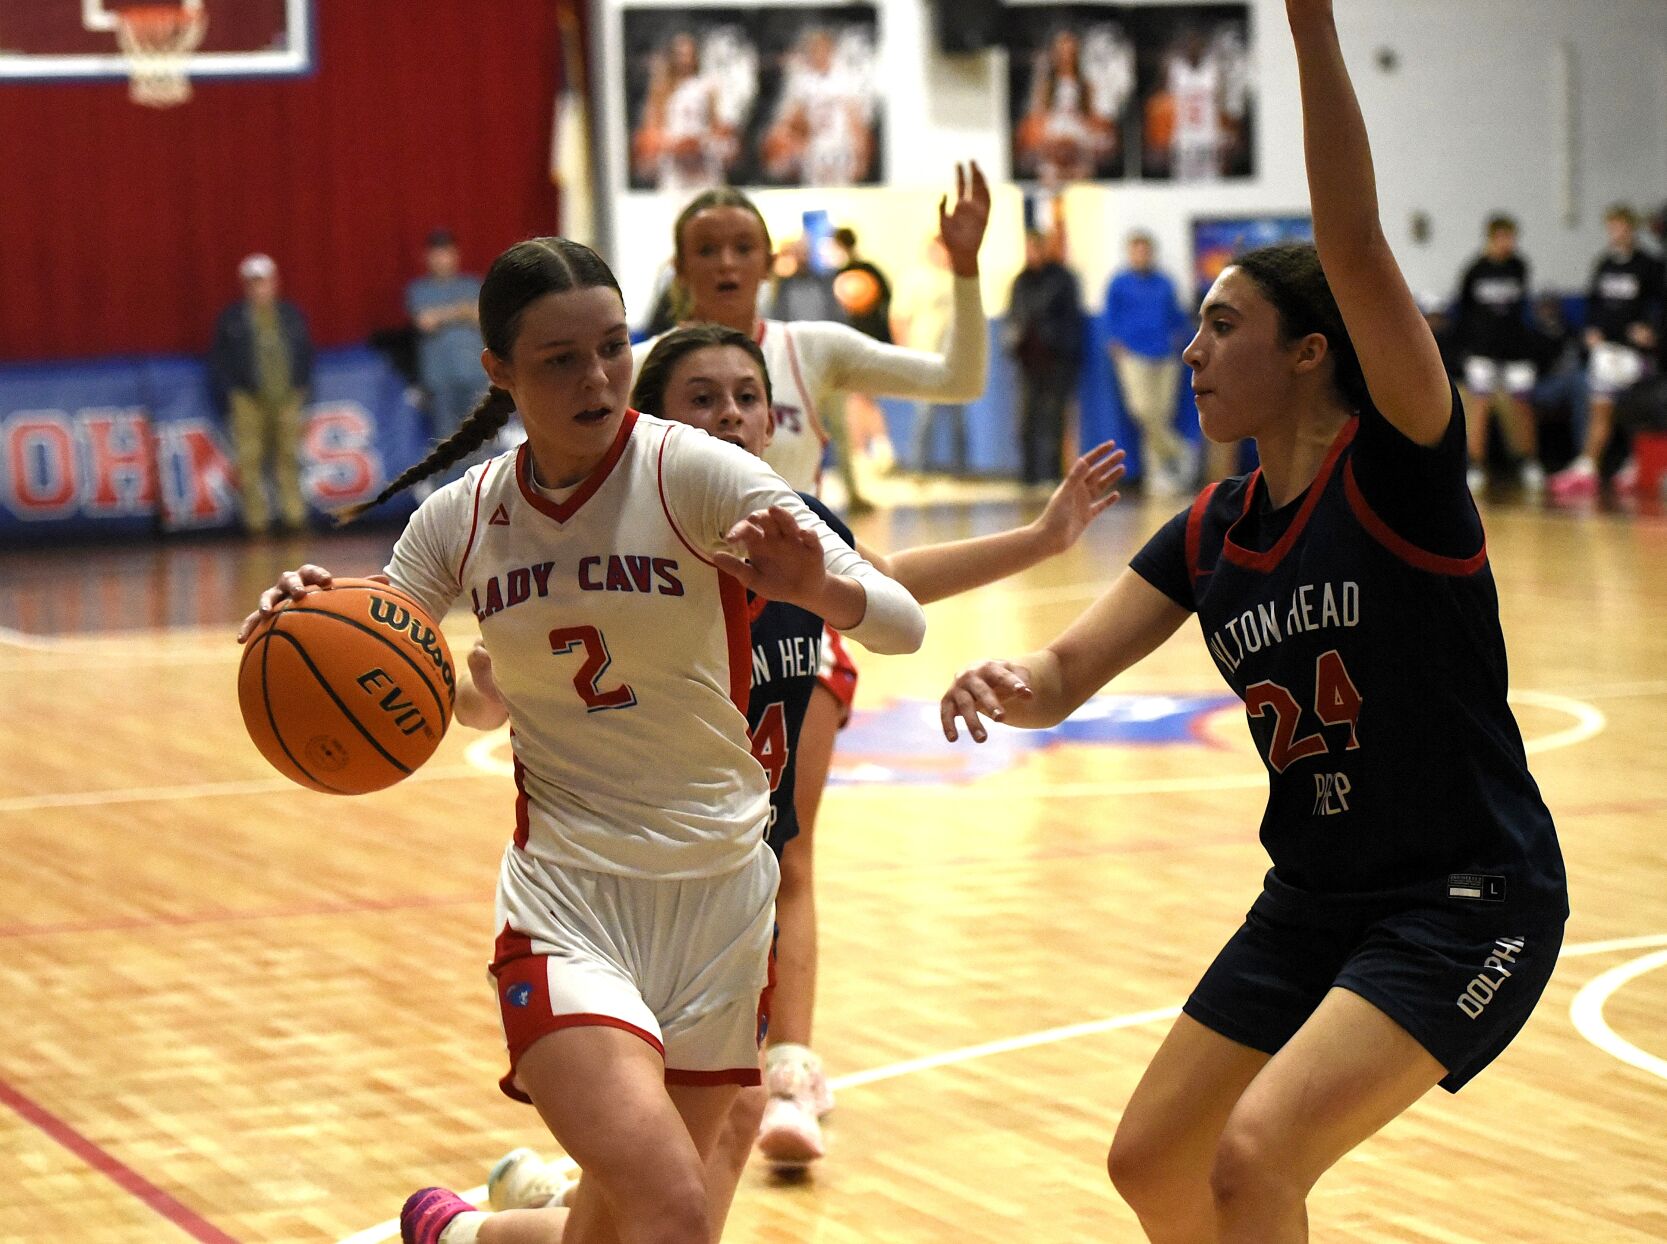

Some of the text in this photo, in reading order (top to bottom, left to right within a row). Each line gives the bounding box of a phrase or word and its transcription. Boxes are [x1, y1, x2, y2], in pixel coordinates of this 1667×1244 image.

[471, 555, 685, 623] LADY CAVS
[1287, 577, 1360, 636] HEAD
[548, 625, 637, 713] 2
[777, 637, 822, 679] HEA
[356, 667, 427, 736] EVO
[1246, 649, 1363, 774] 24
[1312, 771, 1352, 816] PREP
[1490, 882, 1499, 895] L
